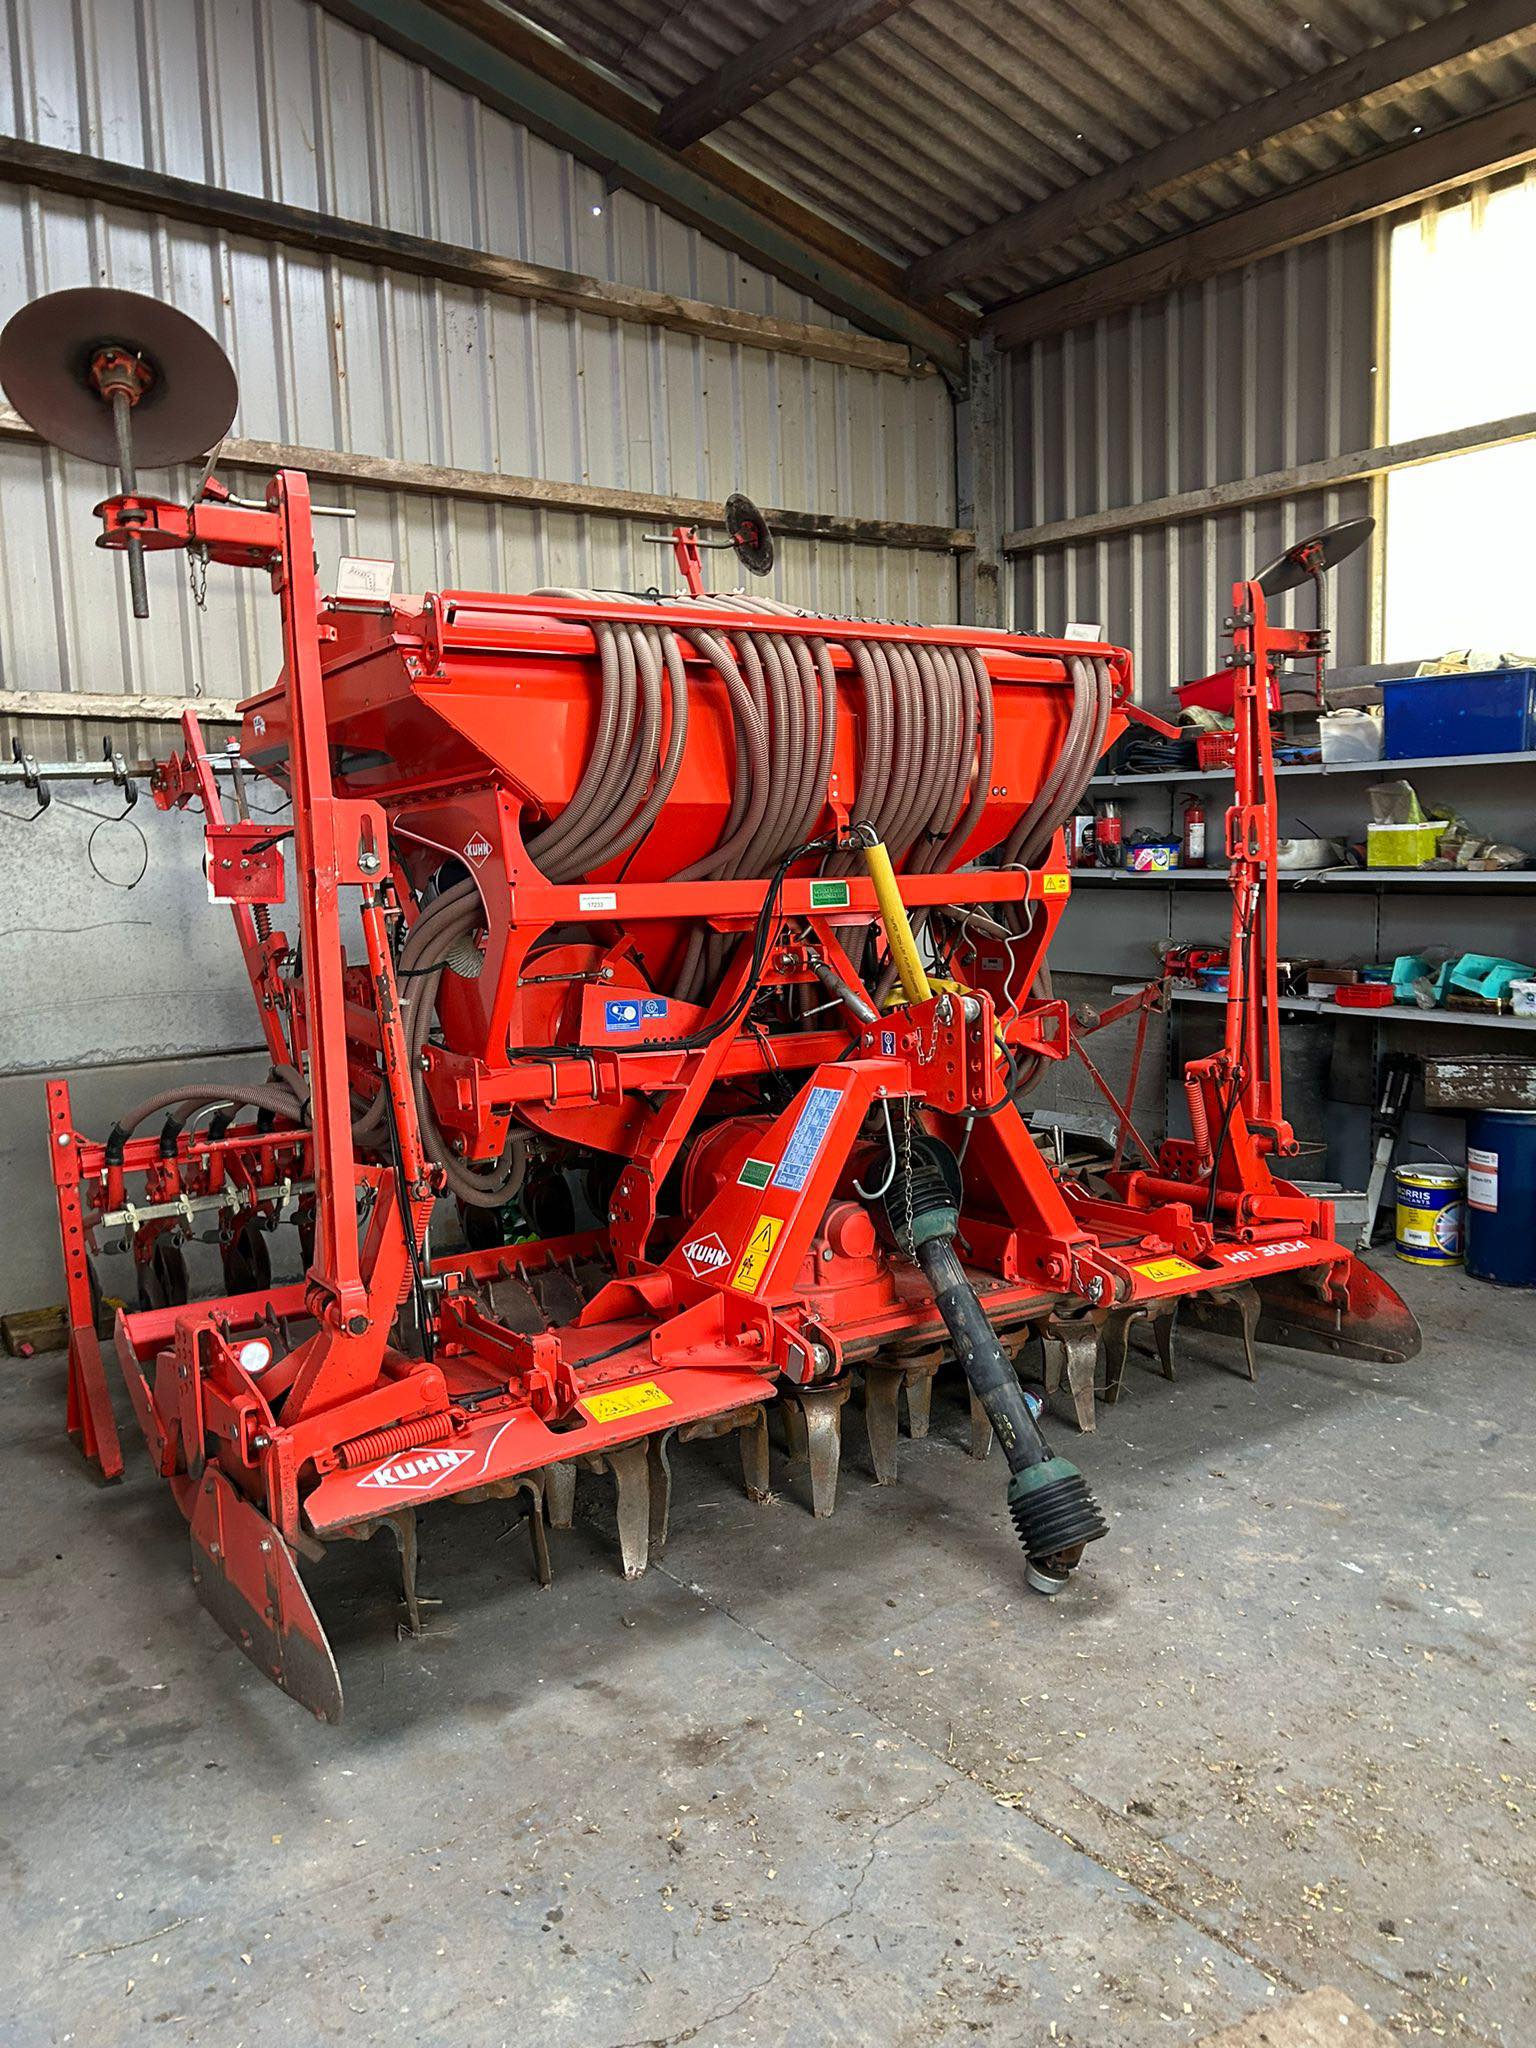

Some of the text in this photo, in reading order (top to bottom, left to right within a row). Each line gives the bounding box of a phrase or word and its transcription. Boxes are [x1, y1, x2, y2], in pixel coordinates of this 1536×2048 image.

[467, 843, 489, 856] KUHN
[687, 1242, 726, 1266] KUHN
[1223, 1239, 1311, 1264] HR 3004
[373, 1451, 460, 1487] KUHN
